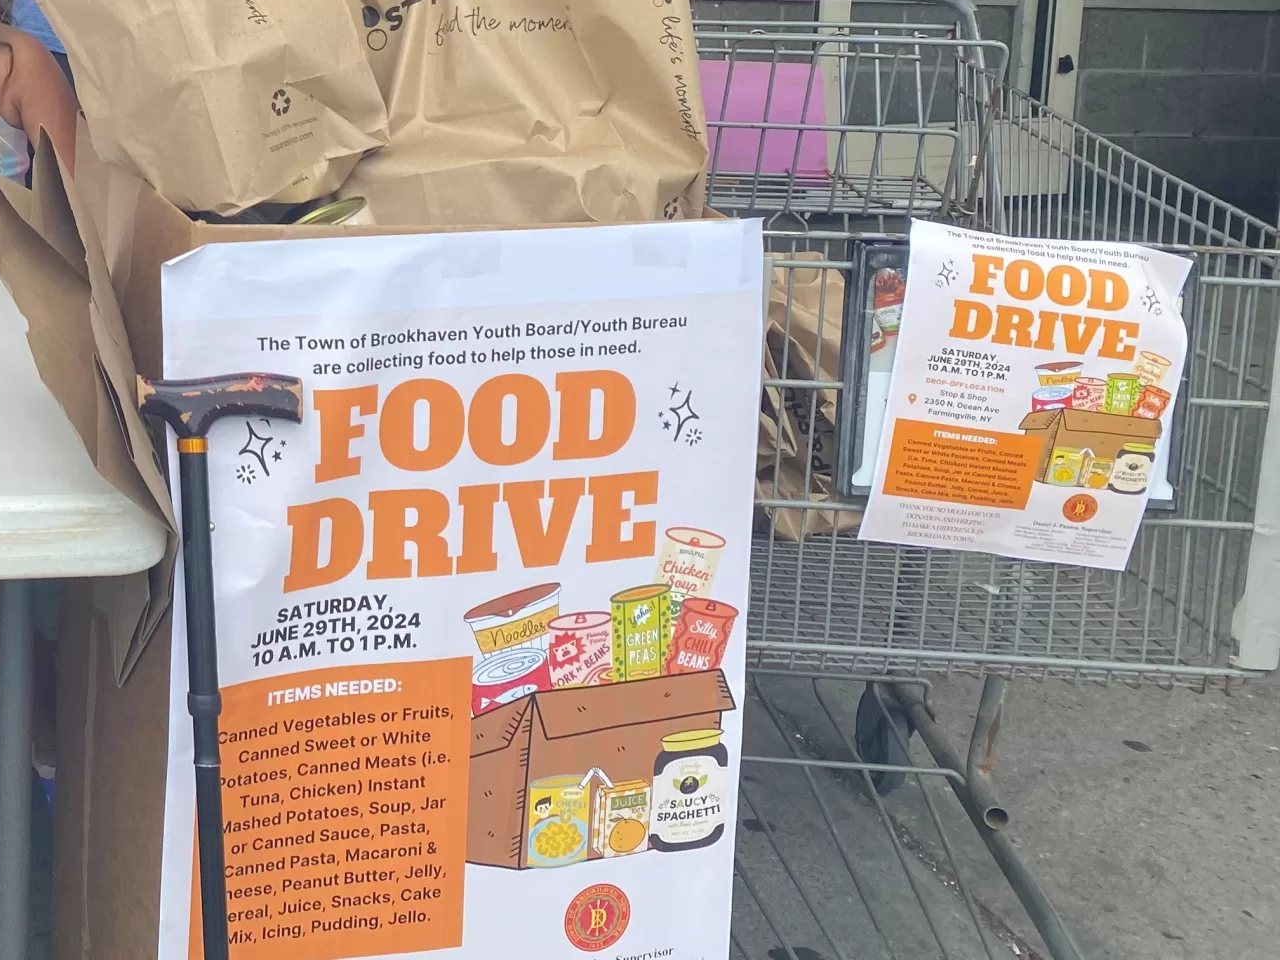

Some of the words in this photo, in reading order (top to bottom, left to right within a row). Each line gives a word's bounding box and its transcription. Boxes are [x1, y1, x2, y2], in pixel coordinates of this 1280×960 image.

[464, 6, 501, 36] the
[947, 231, 962, 240] The
[963, 235, 985, 243] Town
[1044, 243, 1070, 251] Youth
[986, 244, 1025, 256] collecting
[1027, 248, 1045, 257] food
[1056, 252, 1074, 262] help
[1075, 255, 1098, 264] those
[969, 254, 1130, 311] FOOD
[257, 336, 290, 352] The
[295, 335, 345, 351] Town
[349, 333, 367, 349] of
[371, 328, 468, 347] Brookhaven
[472, 324, 521, 340] Youth
[526, 317, 628, 337] Board/Youth
[632, 315, 688, 330] Bureau
[949, 299, 1140, 361] DRIVE
[312, 360, 342, 375] are
[346, 353, 423, 374] collecting
[428, 349, 466, 366] food
[470, 349, 487, 364] to
[491, 346, 526, 365] help
[530, 343, 576, 360] those
[579, 342, 594, 357] in
[598, 340, 642, 355] need.
[927, 355, 953, 365] JUNE
[954, 358, 982, 370] 29TH,
[985, 362, 1010, 372] 2024
[942, 348, 998, 363] SATURDAY,
[926, 378, 964, 387] DROP-OFF
[965, 382, 1005, 393] LOCATION
[940, 365, 962, 374] A.M.
[965, 368, 978, 377] TO
[987, 371, 1007, 381] P.M.
[924, 398, 945, 407] 2350
[957, 402, 982, 412] Ocean
[984, 405, 1000, 413] Ave
[940, 390, 958, 399] Stop
[967, 392, 987, 402] Shop
[312, 369, 638, 484] FOOD
[928, 408, 978, 422] Farmingville,
[980, 415, 992, 423] NY
[934, 430, 960, 440] ITEMS
[961, 433, 998, 444] NEEDED:
[282, 470, 660, 594] DRIVE
[679, 548, 705, 559] SOULFUL
[662, 559, 711, 582] Chicken
[666, 575, 698, 594] Soup
[276, 594, 394, 624] SATURDAY,
[251, 625, 299, 648] JUNE
[303, 616, 361, 638] 29TH,
[366, 613, 421, 631] 2024
[490, 620, 546, 647] Noodles
[626, 628, 659, 648] GREEN
[689, 619, 718, 639] Silly
[252, 648, 274, 667] 10
[278, 641, 321, 661] A.M.
[326, 636, 354, 654] TO
[359, 635, 369, 651] 1
[373, 633, 417, 650] P.M.
[584, 643, 611, 669] BEANS
[629, 647, 657, 665] PEAS
[684, 638, 713, 654] CHILI
[677, 651, 710, 670] BEANS
[267, 683, 322, 706] ITEMS
[325, 678, 403, 697] NEEDED:
[219, 722, 278, 745] Canned
[282, 711, 376, 734] Vegetables
[380, 710, 398, 722] or
[402, 705, 454, 721] Fruits,
[238, 740, 300, 764] Canned
[304, 734, 356, 753] Sweet
[360, 733, 377, 747] or
[382, 730, 431, 745] White
[297, 757, 360, 777] Canned
[364, 753, 417, 770] Meats
[421, 752, 451, 768] (i.e.
[240, 791, 284, 809] Tuna,
[289, 780, 363, 801] Chicken)
[368, 776, 426, 792] Instant
[614, 795, 645, 808] JUICE
[669, 795, 708, 809] SAUCY
[286, 804, 364, 824] Potatoes,
[368, 800, 416, 816] Soup,
[420, 796, 446, 811] Jar
[656, 805, 721, 822] SPAGHETTI
[231, 842, 247, 855] or
[252, 831, 315, 851] Canned
[319, 826, 375, 842] Sauce,
[380, 821, 430, 837] Pasta,
[224, 857, 286, 879] Canned
[290, 851, 340, 869] Pasta,
[345, 842, 422, 863] Macaroni
[427, 842, 437, 854] &
[227, 883, 277, 902] eese,
[282, 875, 340, 893] Peanut
[344, 868, 400, 886] Butter,
[405, 864, 447, 880] Jelly,
[228, 904, 272, 923] ereal,
[278, 899, 326, 916] Juice,
[331, 891, 395, 909] Snacks,
[400, 886, 442, 902] Cake
[262, 923, 306, 941] Icing,
[311, 914, 383, 934] Pudding,
[388, 910, 431, 925] Jello.
